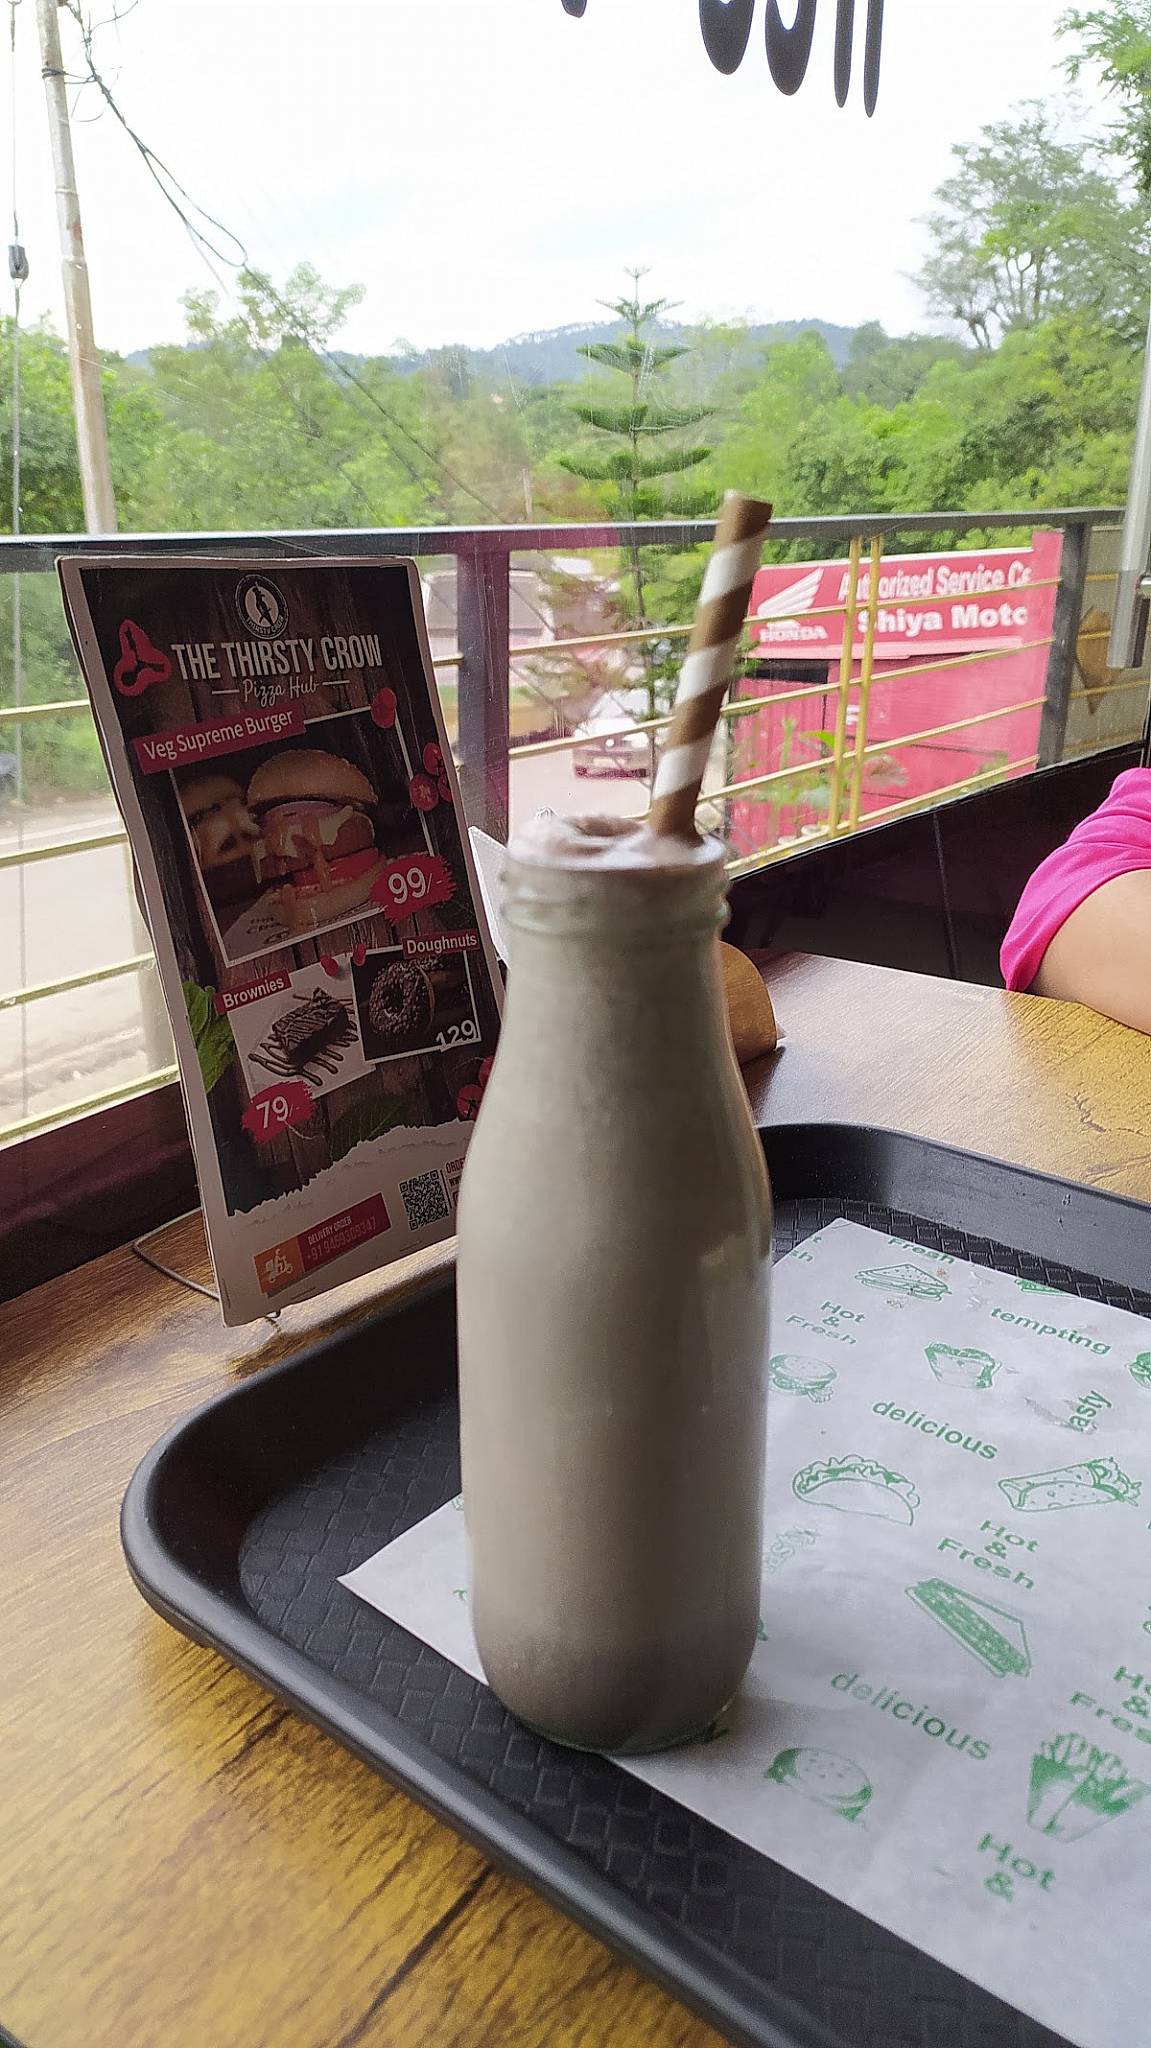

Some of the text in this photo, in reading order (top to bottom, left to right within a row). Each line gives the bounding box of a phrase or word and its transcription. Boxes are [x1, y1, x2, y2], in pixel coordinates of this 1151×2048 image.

[936, 563, 1006, 595] Service
[759, 625, 828, 642] HONDA
[171, 634, 383, 680] THE THIRSTY CROW
[242, 676, 321, 708] Pizza Hub
[143, 710, 293, 760] Veg Supreme Burger
[407, 933, 477, 954] Doughnuts
[222, 977, 285, 1008] Brownies
[307, 1226, 334, 1246] DELIVERY
[887, 1236, 956, 1264] Fresh
[820, 1301, 866, 1323] Hot
[822, 1315, 840, 1329] &
[785, 1314, 858, 1345] Fresh
[991, 1308, 1112, 1355] tempting
[872, 1401, 998, 1460] delicious
[979, 1519, 1039, 1553] Hot
[984, 1541, 1007, 1560] &
[937, 1537, 1034, 1589] Fresh
[831, 1672, 990, 1760] delicious
[977, 1833, 1055, 1889] Hot
